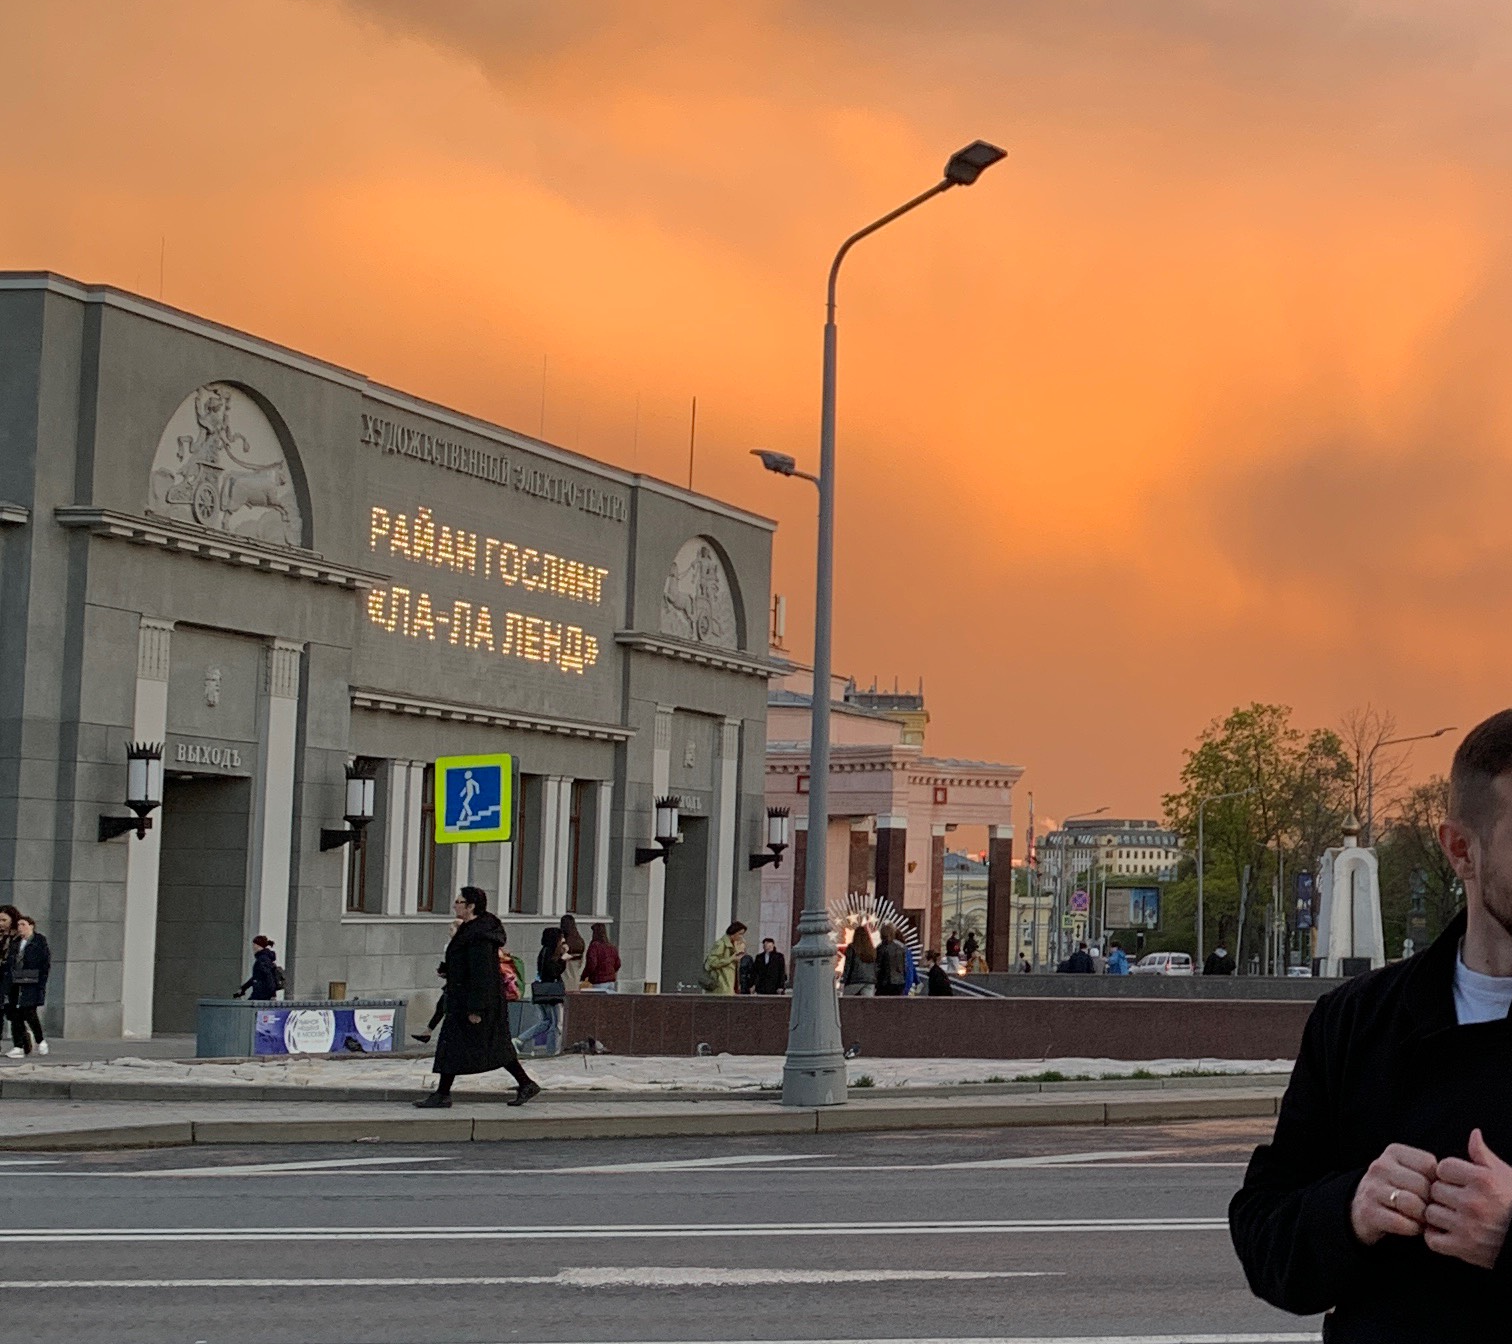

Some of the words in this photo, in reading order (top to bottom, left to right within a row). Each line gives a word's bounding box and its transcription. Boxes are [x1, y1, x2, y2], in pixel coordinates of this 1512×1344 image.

[362, 415, 511, 485] ХУДОЖЕСТВЕННЫЙ
[370, 506, 477, 577] РАЙАН
[485, 538, 609, 607] ГОСЛИНГ
[502, 611, 600, 676] ЛЕНД»
[176, 743, 241, 769] ВЫХОДЪ
